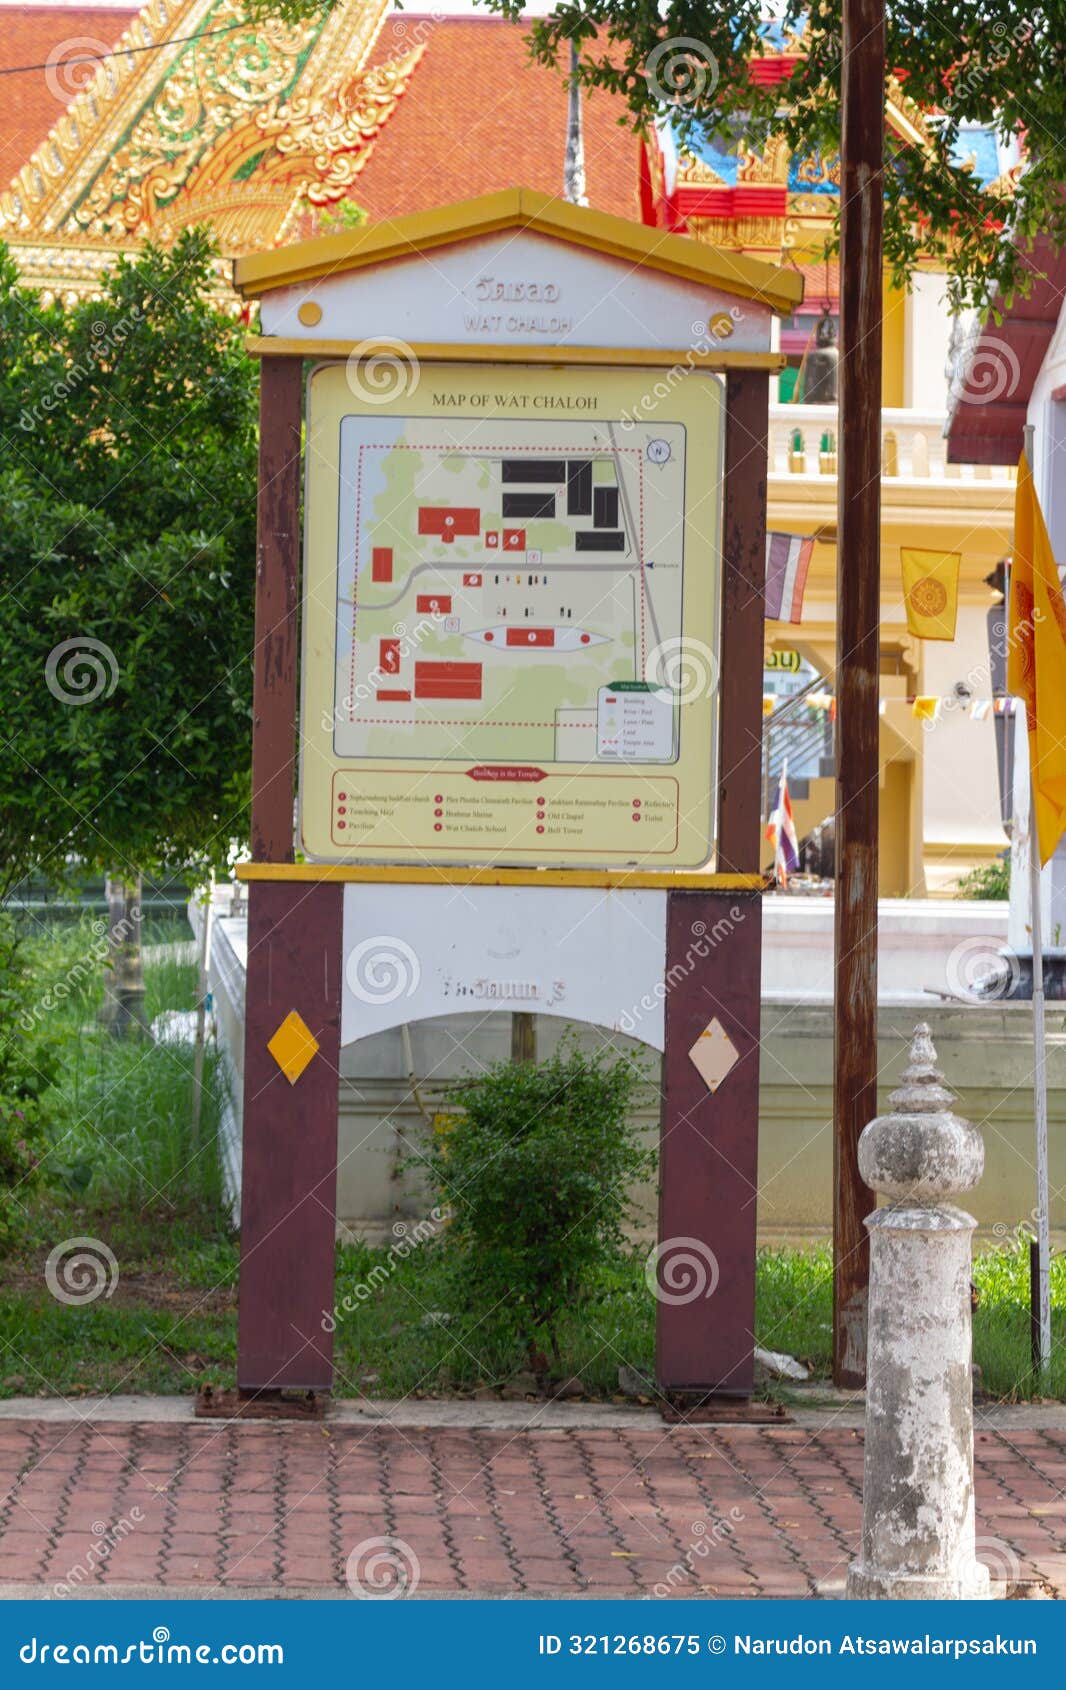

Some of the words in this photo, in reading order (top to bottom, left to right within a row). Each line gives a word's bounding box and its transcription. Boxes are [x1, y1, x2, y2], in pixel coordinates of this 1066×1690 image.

[464, 315, 502, 333] WAT
[506, 316, 572, 333] CHALOH
[432, 394, 466, 407] MAP
[470, 394, 490, 407] OF
[494, 395, 530, 408] WAT
[533, 396, 598, 409] CHALOH
